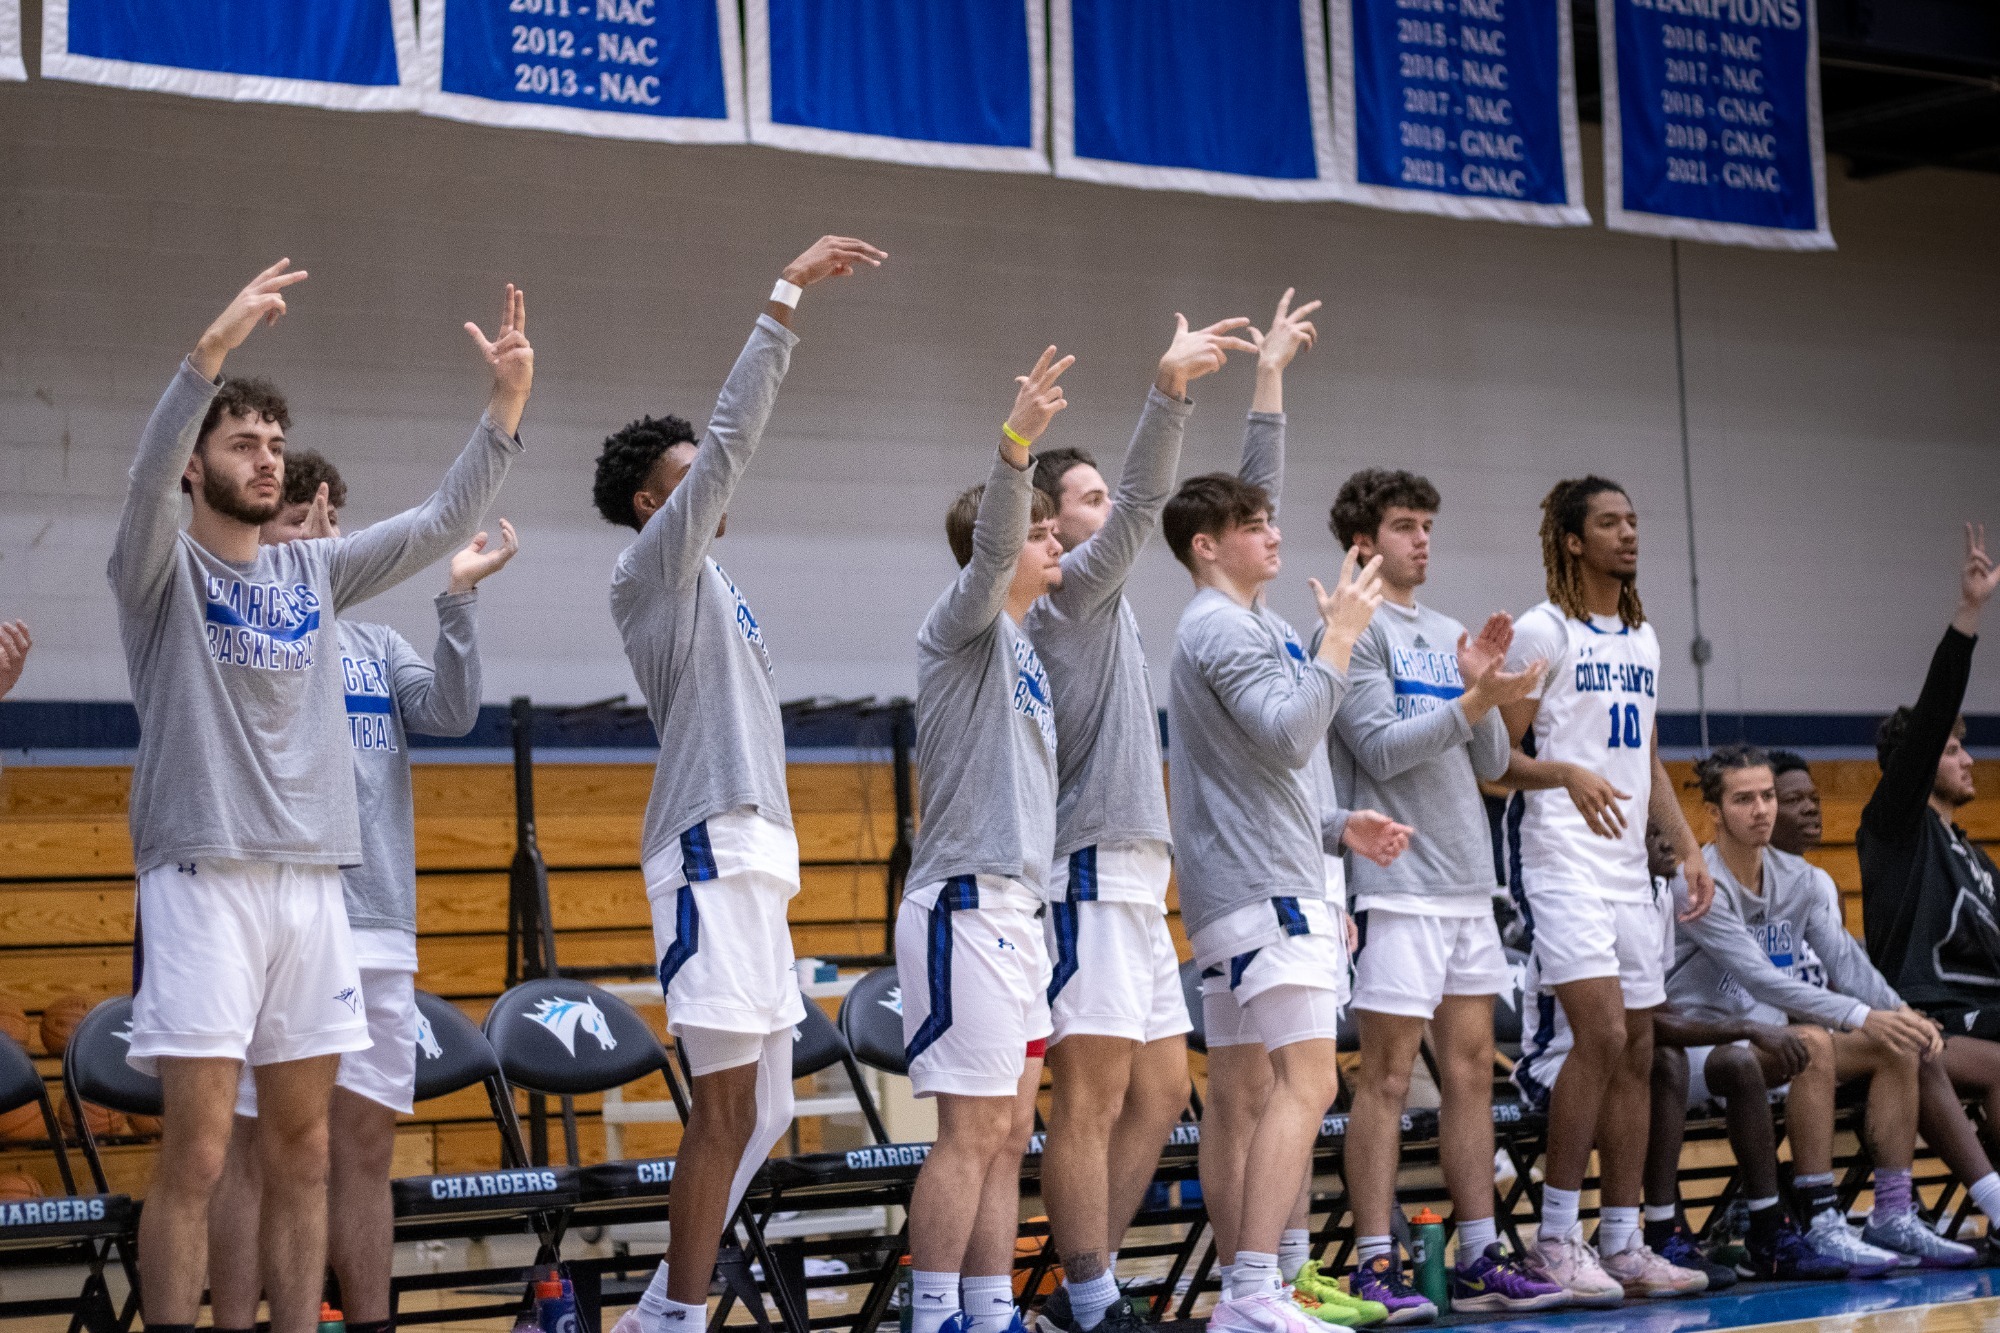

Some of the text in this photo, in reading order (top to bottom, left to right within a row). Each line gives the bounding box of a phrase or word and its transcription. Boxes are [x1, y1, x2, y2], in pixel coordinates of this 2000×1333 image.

[1608, 702, 1641, 749] 10
[431, 1171, 558, 1200] CHARGERS
[0, 1199, 105, 1227] ARGERS
